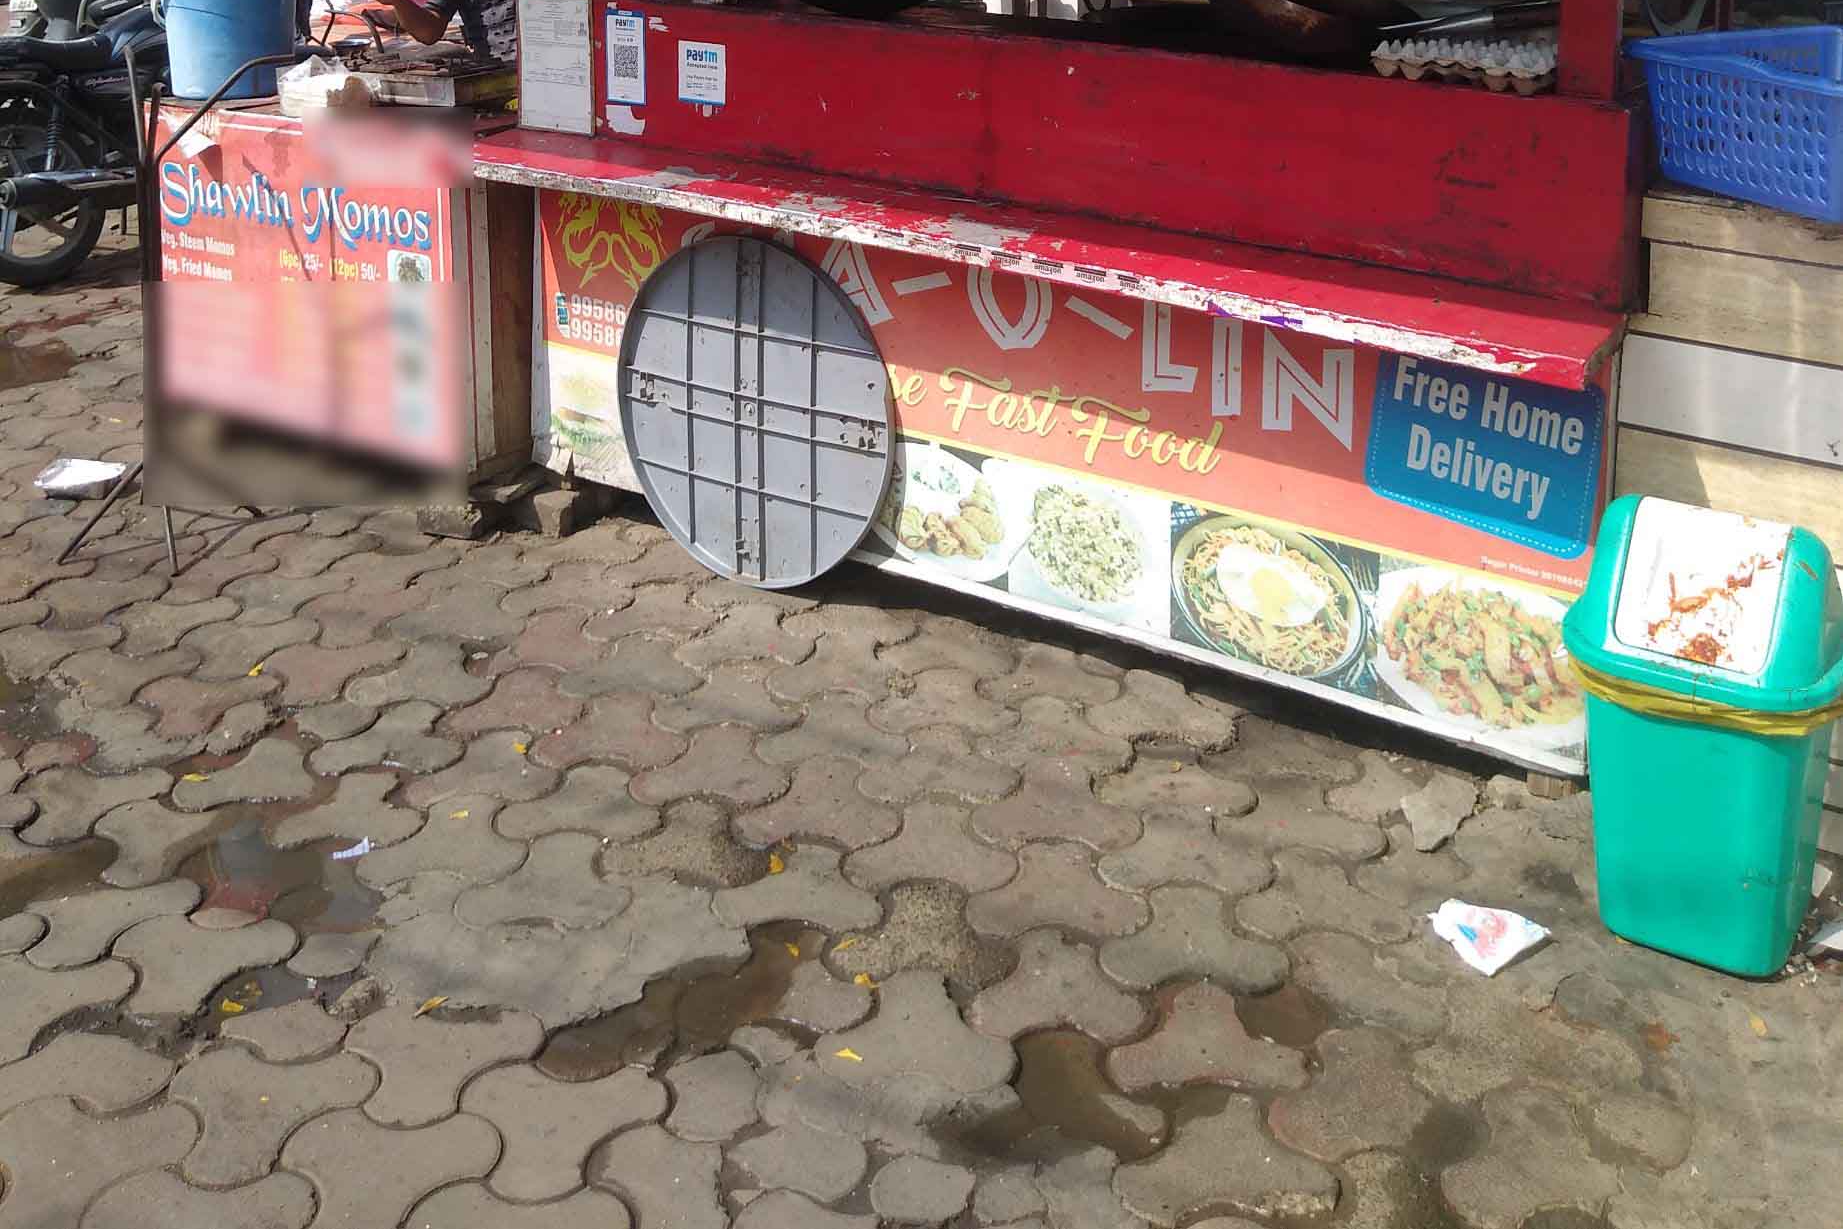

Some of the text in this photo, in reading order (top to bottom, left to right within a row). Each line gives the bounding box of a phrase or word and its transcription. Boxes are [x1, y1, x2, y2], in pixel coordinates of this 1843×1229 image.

[160, 161, 432, 251] Shawlin Momos
[938, 366, 1077, 439] Fast
[1070, 395, 1224, 476] Food
[1393, 355, 1585, 456] Free Home
[1406, 423, 1551, 520] Delivery
